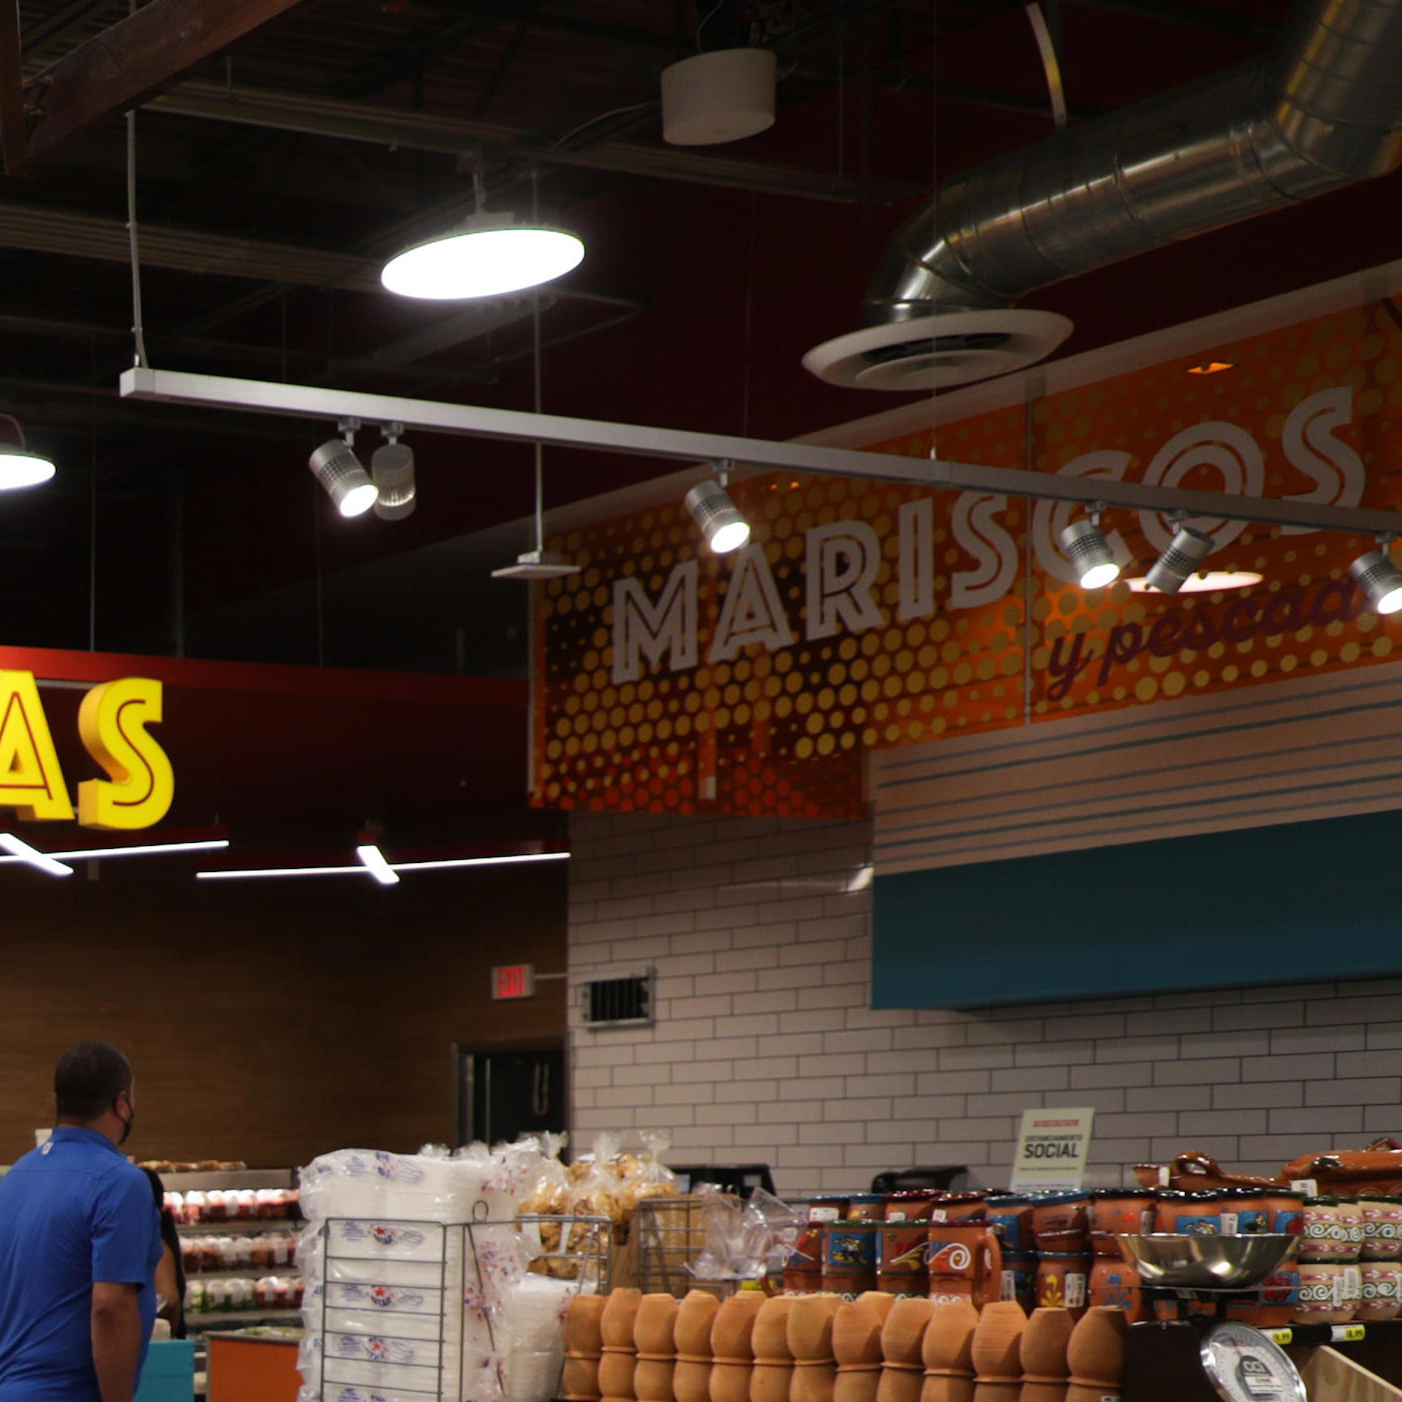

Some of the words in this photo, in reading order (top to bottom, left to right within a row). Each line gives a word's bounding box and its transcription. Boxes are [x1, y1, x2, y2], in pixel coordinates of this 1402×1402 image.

[612, 386, 1366, 686] MARISCOS
[499, 966, 525, 997] EXIT
[1024, 1143, 1079, 1159] SOCIAL
